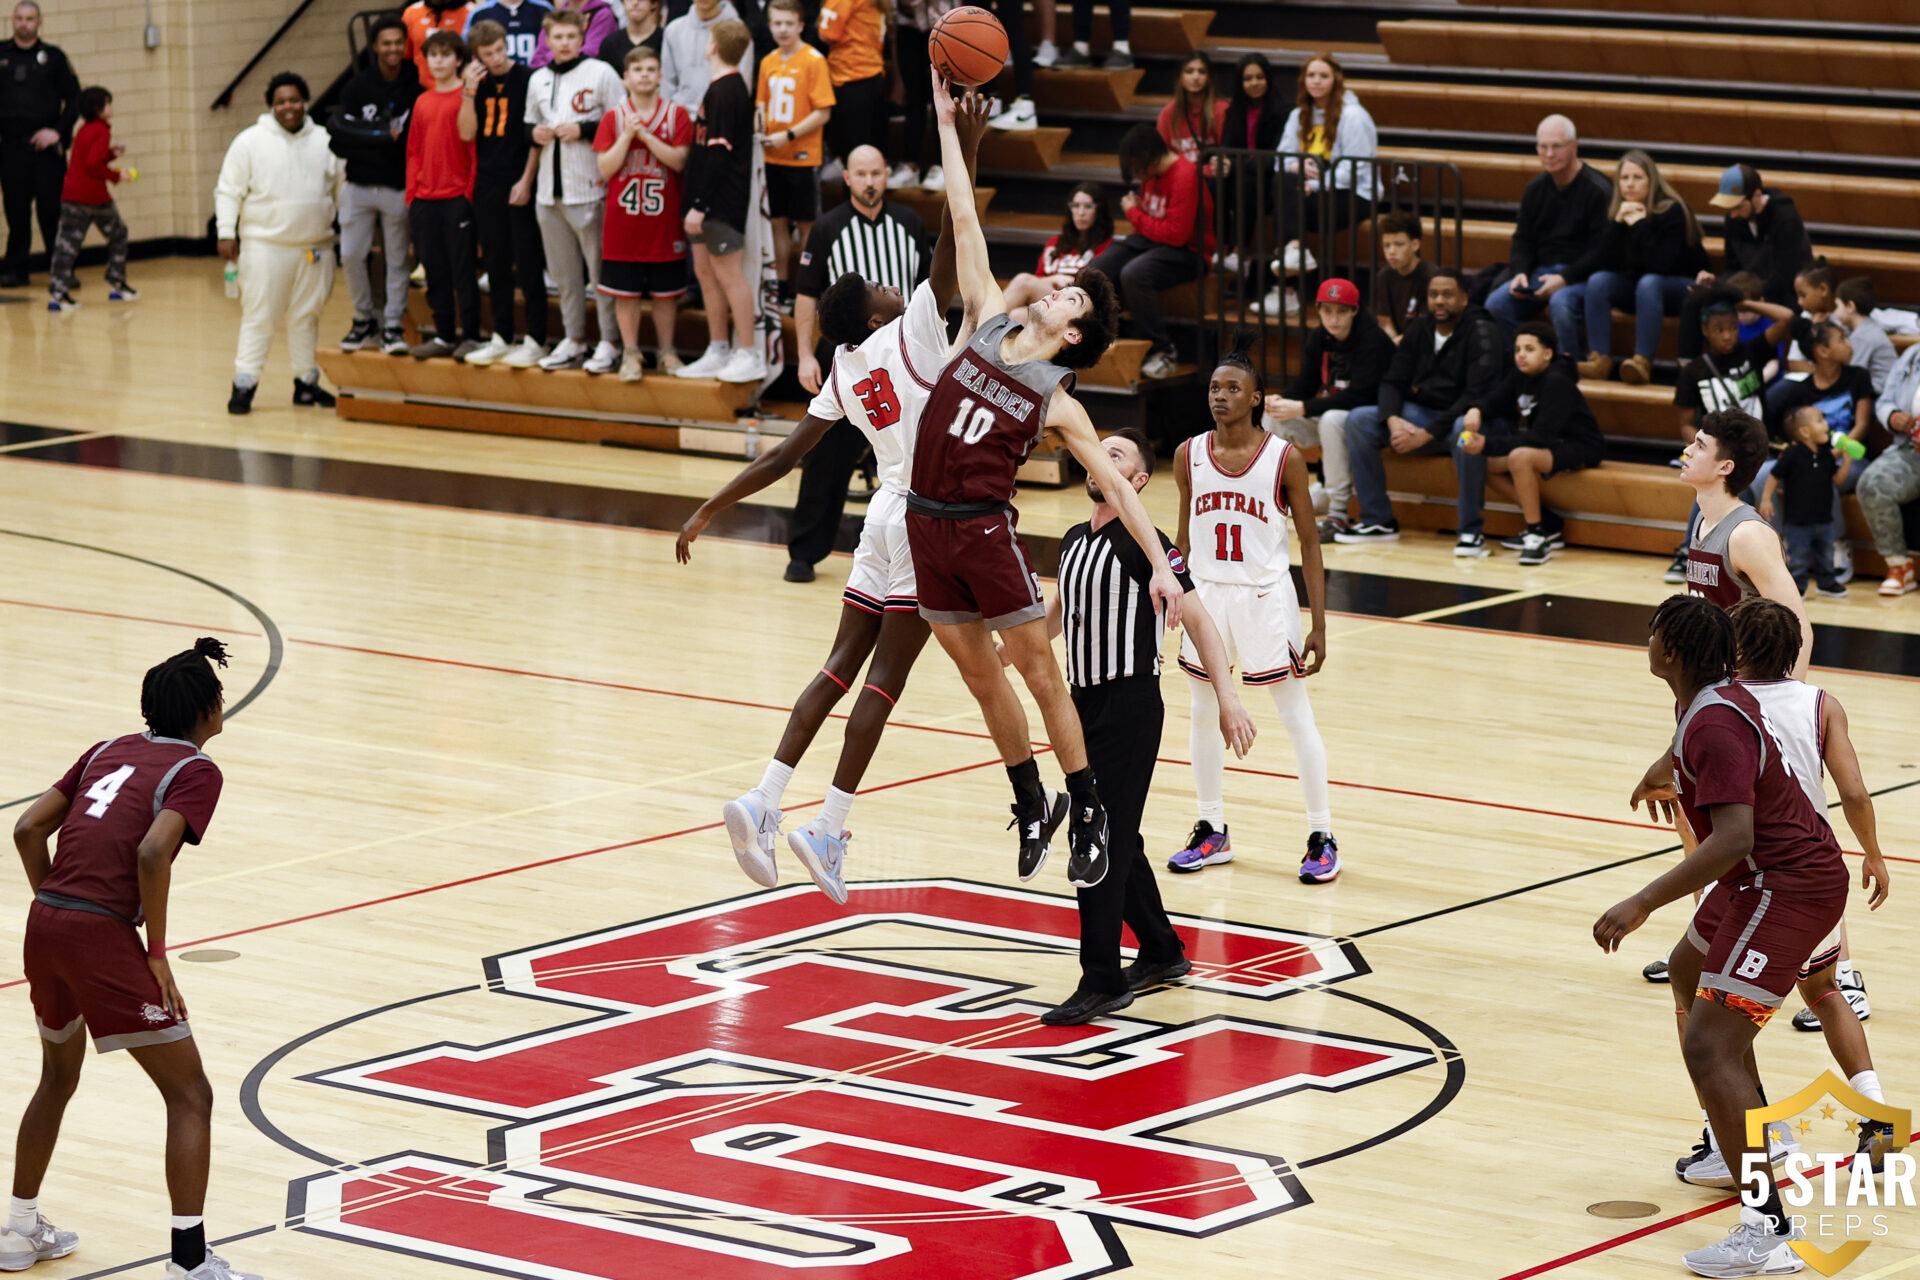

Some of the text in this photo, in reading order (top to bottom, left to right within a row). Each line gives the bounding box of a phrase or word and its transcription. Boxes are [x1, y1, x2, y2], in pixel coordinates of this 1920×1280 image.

[820, 8, 838, 29] T
[483, 97, 509, 137] 11
[571, 88, 595, 114] C
[617, 177, 665, 216] 45
[853, 367, 901, 431] 33
[952, 358, 1035, 423] BEARDEN
[948, 397, 996, 445] 10
[1196, 491, 1268, 524] CENTRAL
[1215, 522, 1243, 562] 11
[84, 764, 136, 819] 4
[1736, 949, 1768, 979] B
